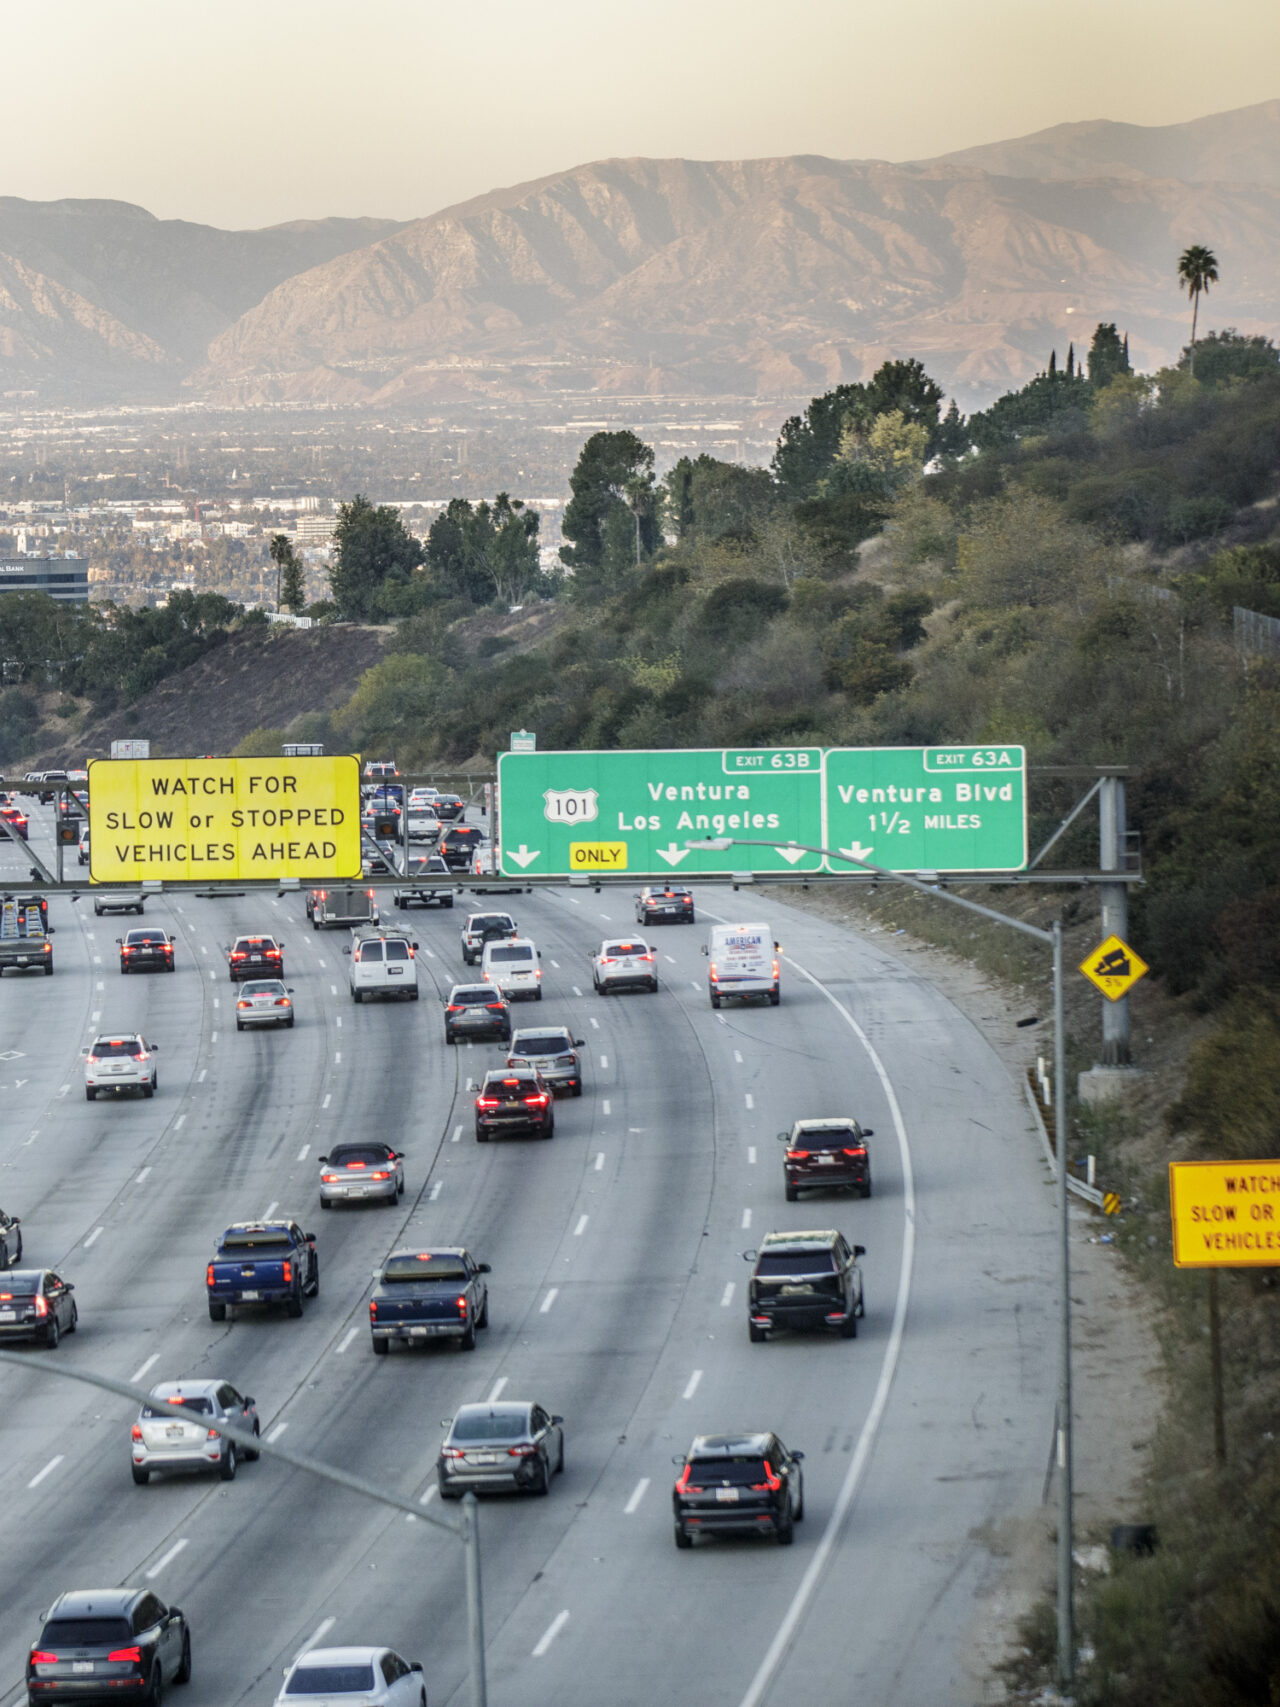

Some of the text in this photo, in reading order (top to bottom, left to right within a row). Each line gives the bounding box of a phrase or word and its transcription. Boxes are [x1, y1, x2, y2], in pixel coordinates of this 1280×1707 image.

[735, 753, 810, 768] EXIT 63B
[936, 751, 1011, 766] EXIT 63A
[152, 776, 297, 796] WATCH FOR
[647, 782, 750, 801] Ventura
[838, 783, 1013, 803] Ventura Blvd
[555, 798, 588, 816] 101
[106, 808, 345, 830] SLOW or STOPPED
[618, 811, 780, 834] Los Angeles
[924, 814, 982, 829] MILES
[116, 842, 337, 863] VEHICLES AHEAD
[575, 848, 621, 863] ONLY
[725, 936, 761, 945] AMERICAN
[1224, 1175, 1280, 1194] WATCH
[1191, 1203, 1275, 1222] SLOW OR
